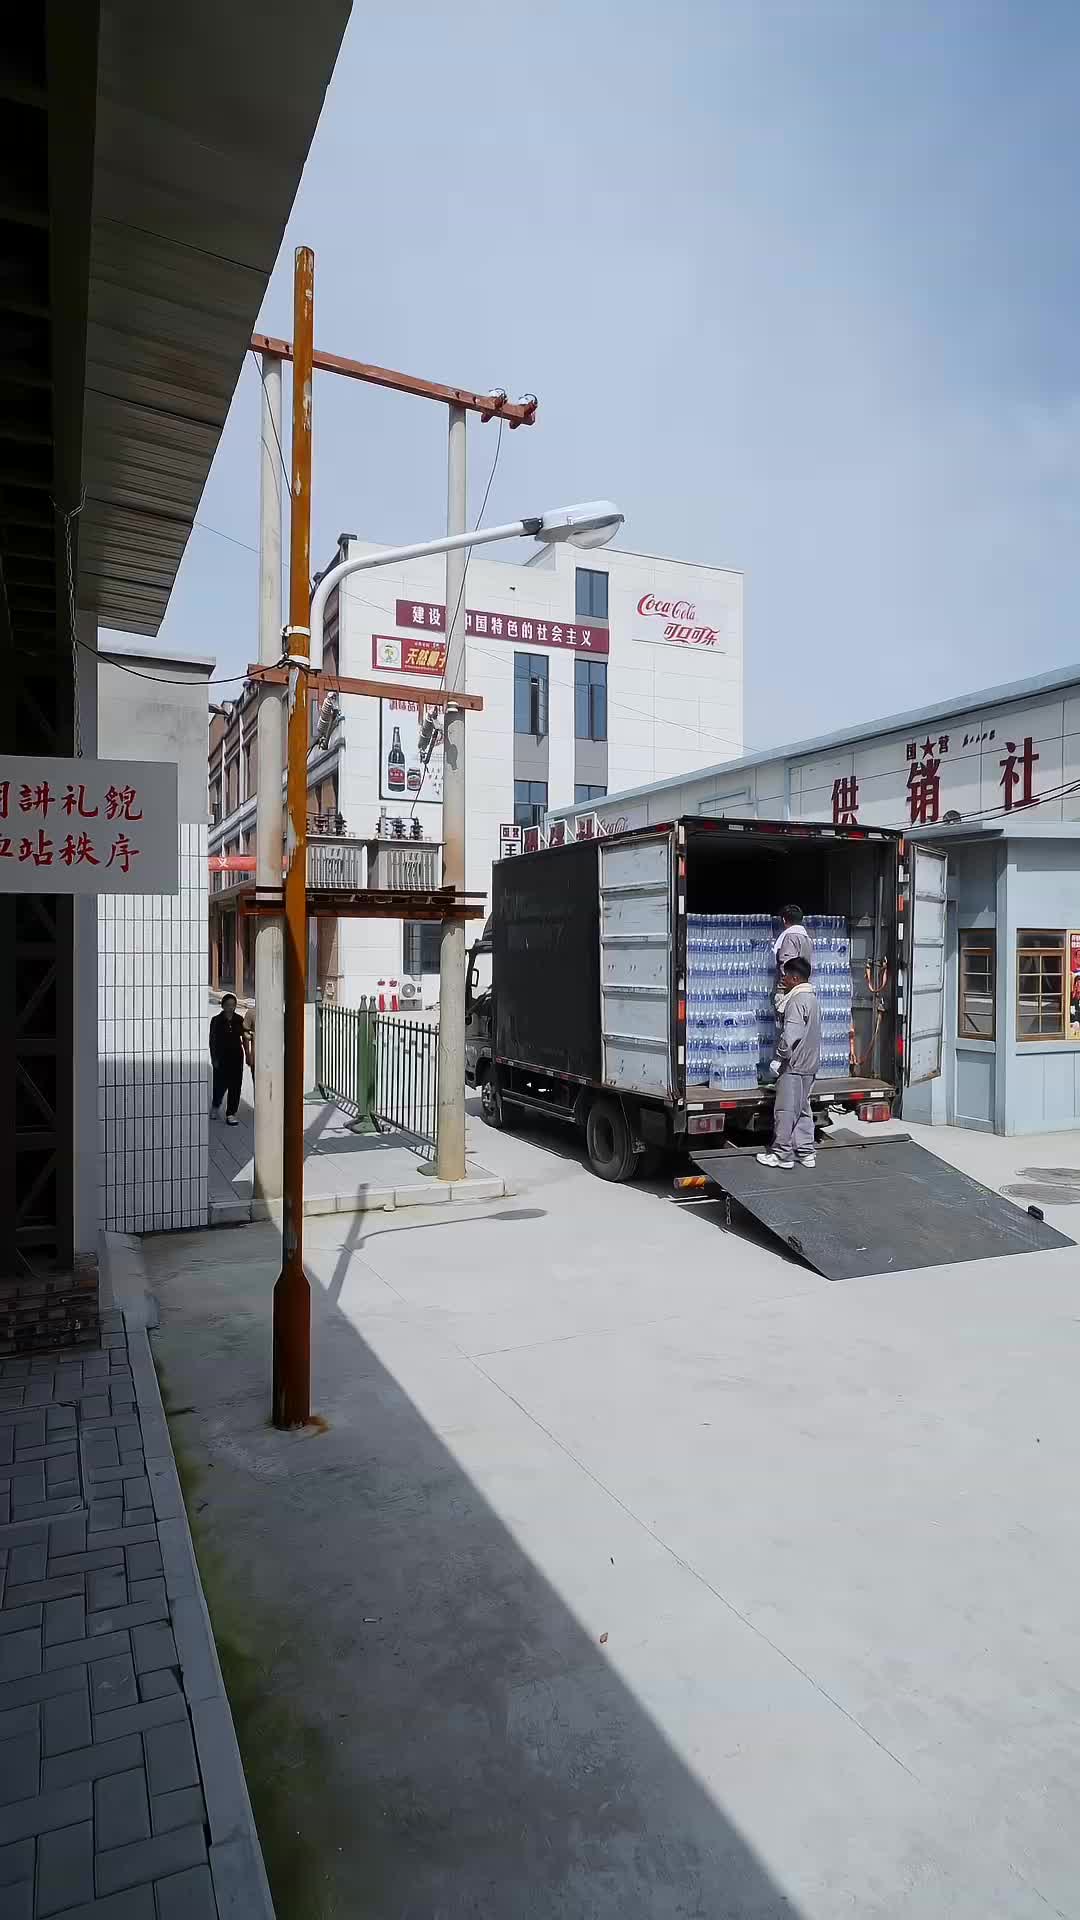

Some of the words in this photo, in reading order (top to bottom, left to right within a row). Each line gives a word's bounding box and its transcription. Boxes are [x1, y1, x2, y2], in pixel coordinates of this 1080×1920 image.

[411, 605, 592, 647] 建设中国特色的社会主义
[664, 622, 720, 646] 可口可乐
[831, 736, 1041, 824] 供销社
